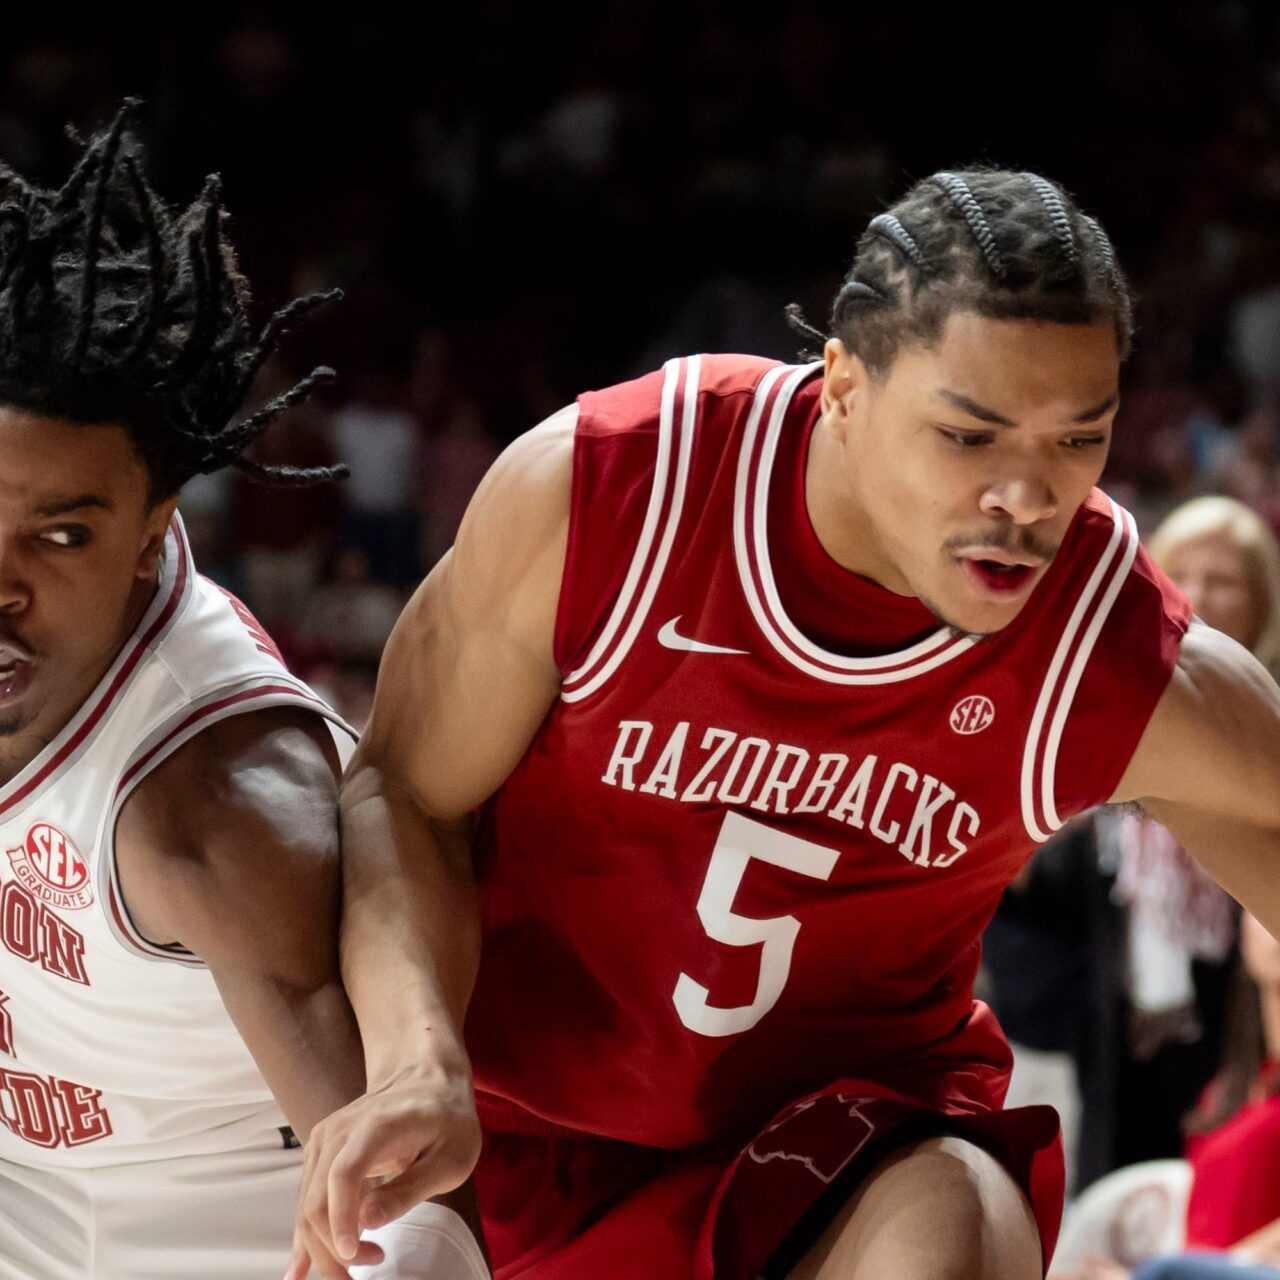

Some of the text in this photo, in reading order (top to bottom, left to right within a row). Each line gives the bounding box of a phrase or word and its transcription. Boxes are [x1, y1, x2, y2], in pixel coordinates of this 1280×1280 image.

[951, 697, 994, 733] SEC
[601, 719, 981, 868] RAZORBACKS
[16, 864, 87, 908] GRADUATE
[30, 825, 85, 888] SEC
[672, 810, 841, 1037] 5
